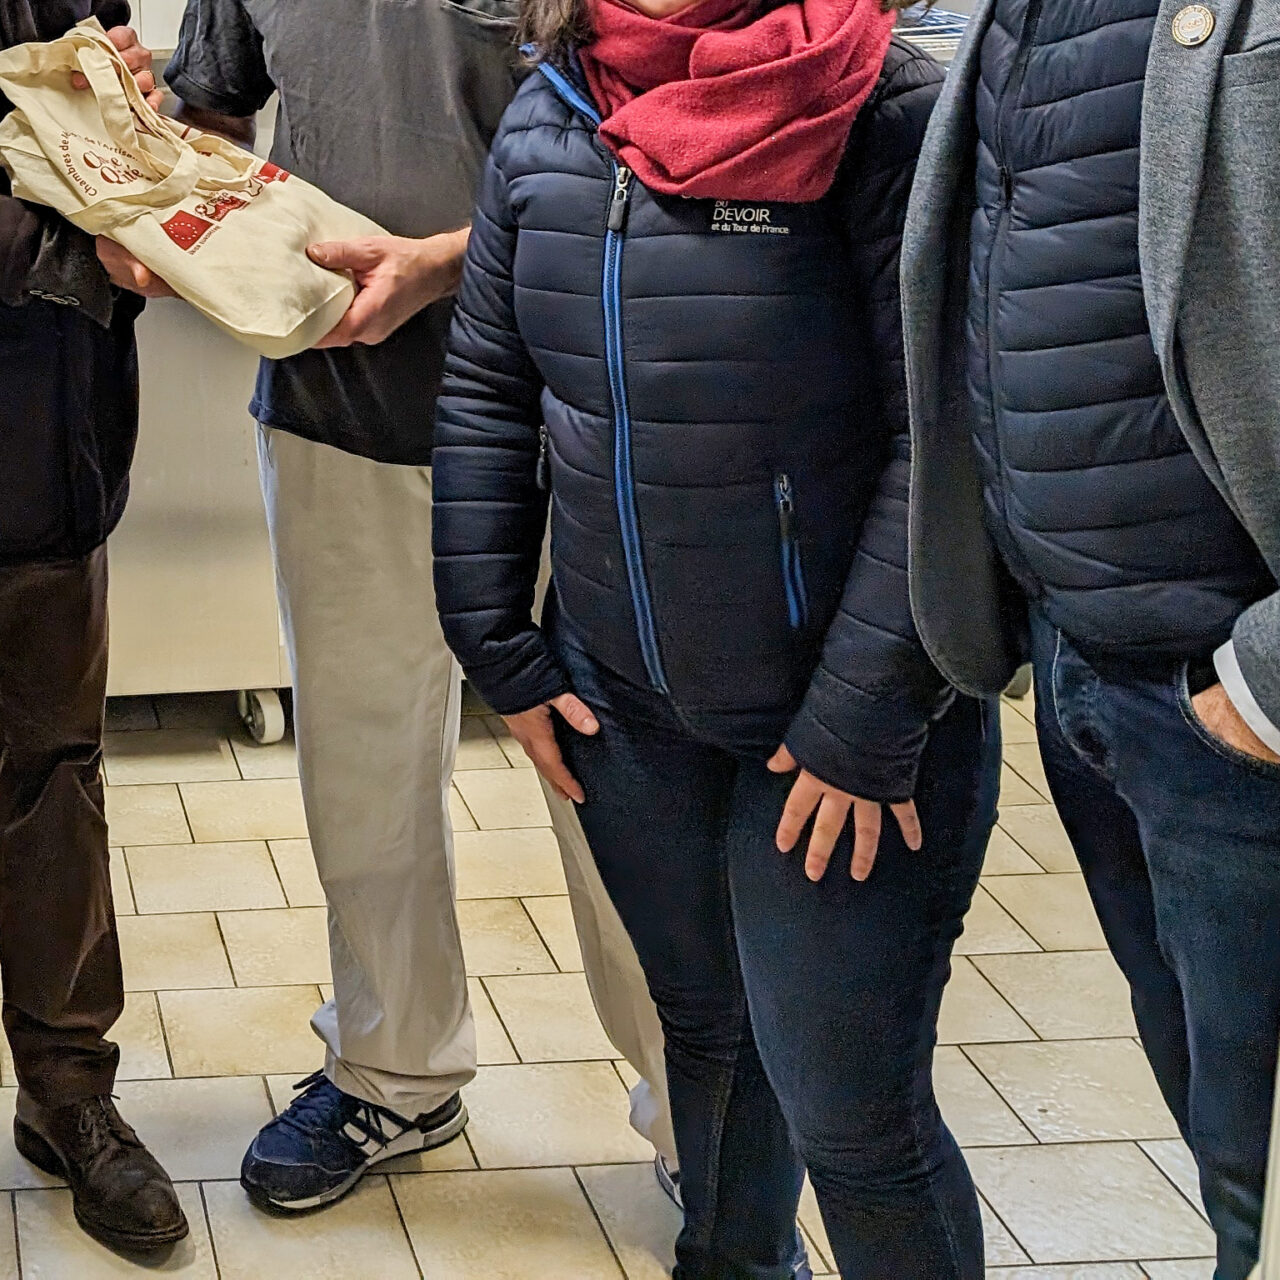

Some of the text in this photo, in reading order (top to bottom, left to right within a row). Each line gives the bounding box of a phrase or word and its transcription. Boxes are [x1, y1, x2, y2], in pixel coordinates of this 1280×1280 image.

[62, 153, 98, 197] Chambres
[713, 208, 771, 223] DEVOIR
[711, 223, 789, 234] et du Tour de France
